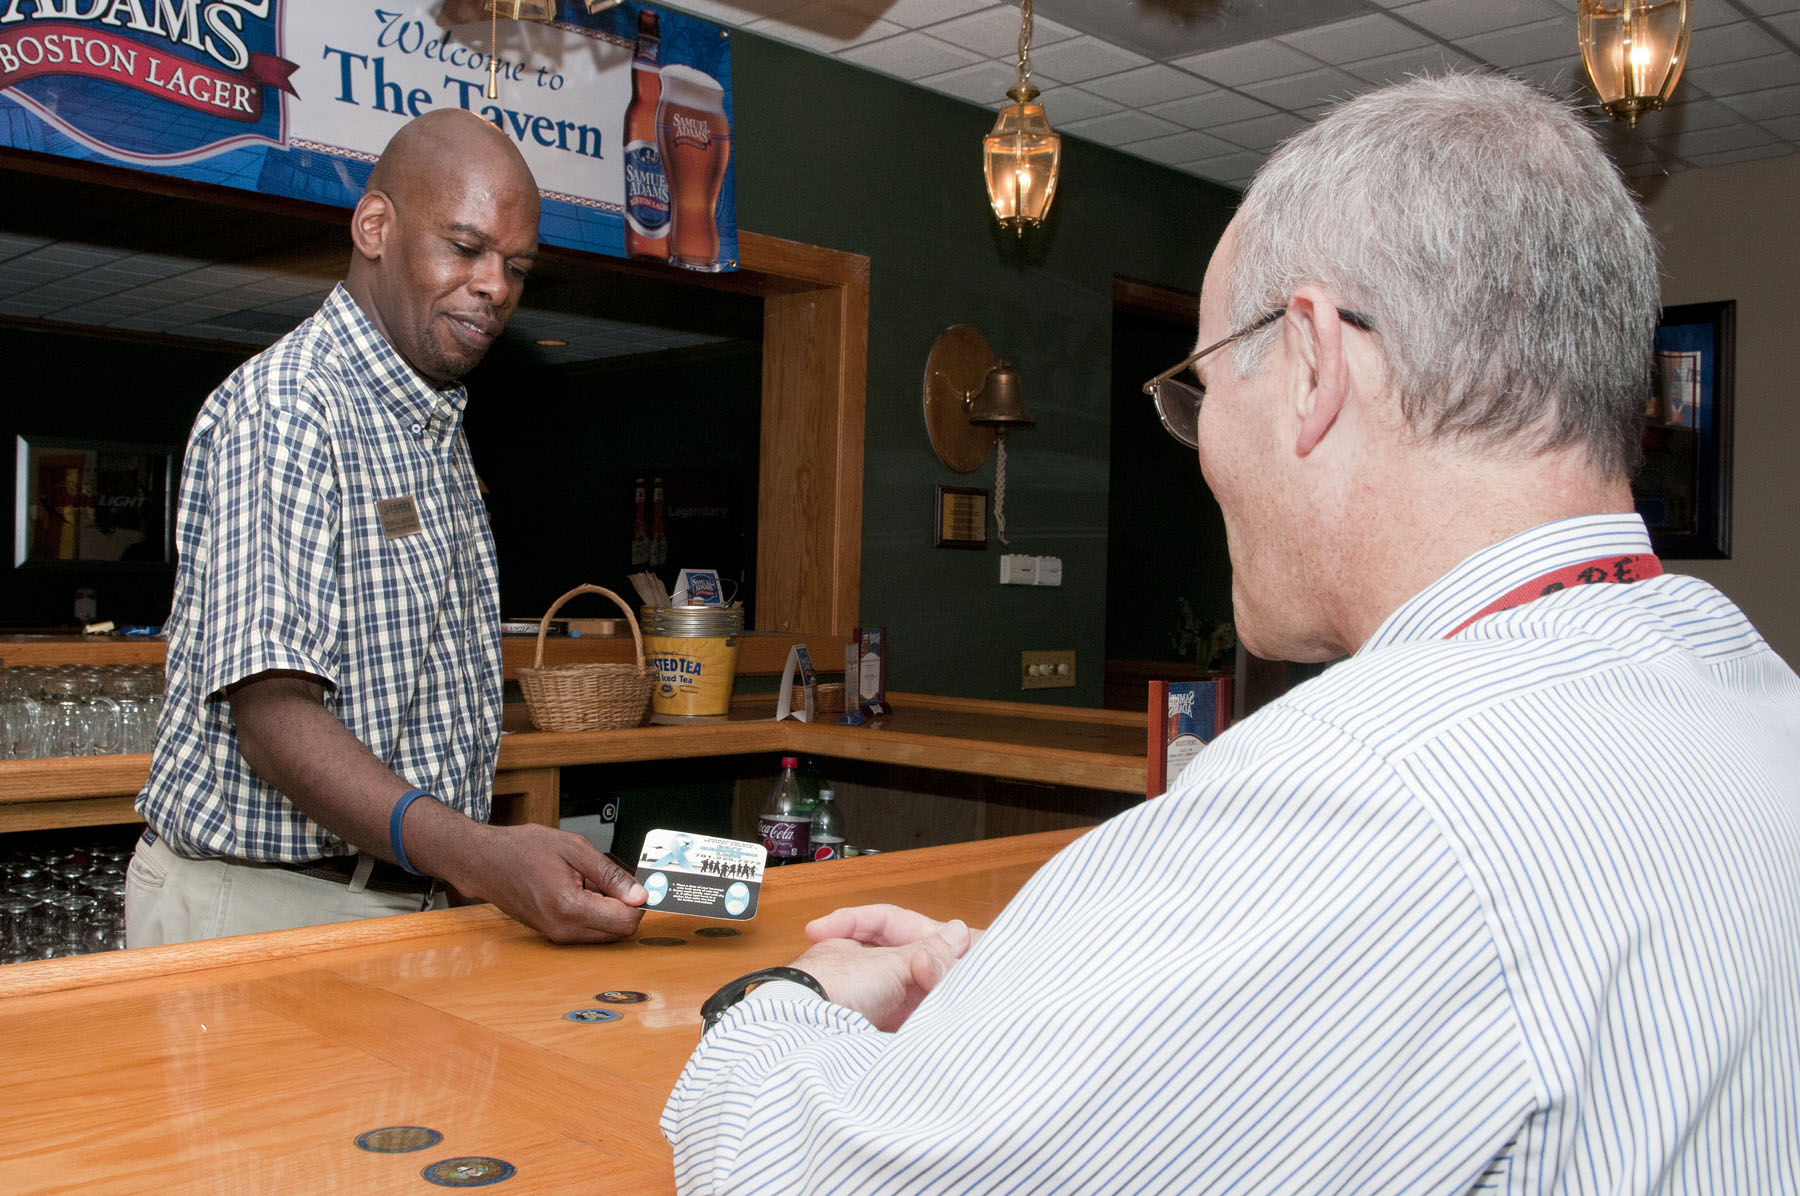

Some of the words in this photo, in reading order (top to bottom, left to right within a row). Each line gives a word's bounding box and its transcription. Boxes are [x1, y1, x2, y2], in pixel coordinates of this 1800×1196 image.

[375, 8, 525, 82] Welcome
[537, 66, 564, 91] to
[0, 34, 137, 75] BOSTON
[145, 56, 254, 113] LAGER
[323, 45, 433, 120] The
[443, 74, 604, 160] Tavern
[673, 113, 708, 134] SAMUEL
[626, 165, 668, 188] SAMUE
[629, 182, 670, 203] ADAMS
[652, 658, 678, 672] STED
[679, 658, 701, 676] TEA
[680, 675, 693, 684] Tea
